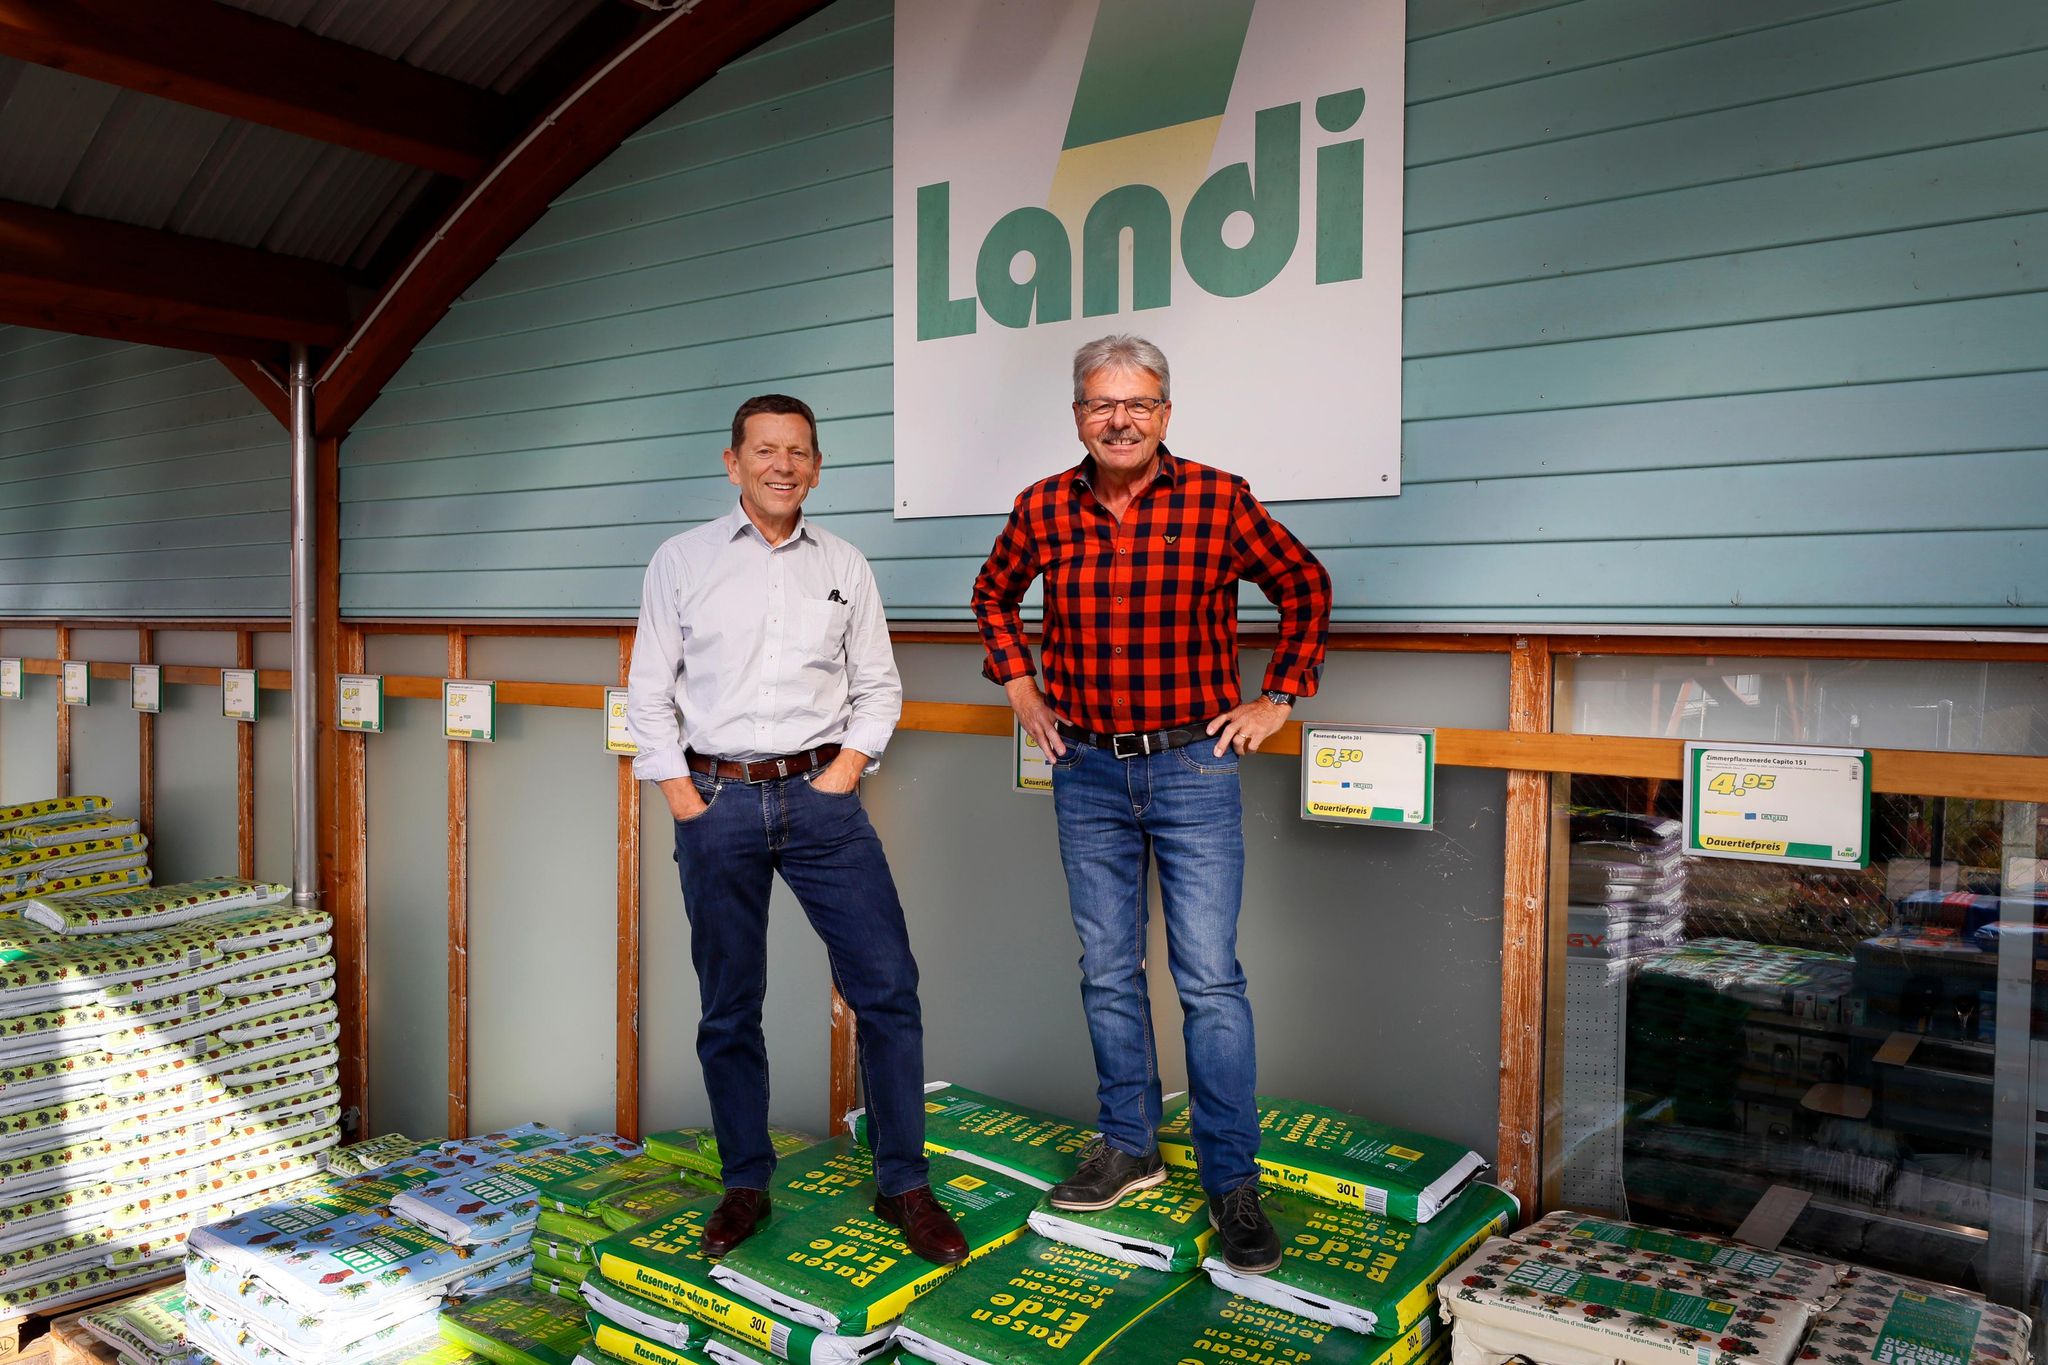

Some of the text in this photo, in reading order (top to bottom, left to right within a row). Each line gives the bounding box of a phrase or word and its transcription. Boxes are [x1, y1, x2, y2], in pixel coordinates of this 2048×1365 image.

[917, 88, 1365, 341] Landi
[1706, 754, 1772, 764] Zimmerpflanzenerde
[1773, 758, 1794, 766] Capito
[1313, 803, 1367, 815] Dauertiefpreis
[1706, 837, 1781, 852] Dauertiefpreis
[1837, 850, 1857, 858] Landi
[1282, 1169, 1308, 1184] Torf
[846, 1218, 904, 1236] gazon
[1119, 1200, 1192, 1224] Rase
[1313, 1211, 1411, 1240] de gazon
[629, 1209, 703, 1249] Rasen
[652, 1216, 705, 1254] Erd
[832, 1226, 912, 1255] terreau
[1305, 1220, 1405, 1252] terreau
[336, 1247, 381, 1272] ERDE
[809, 1239, 897, 1274] Erde
[1040, 1253, 1131, 1280] terriccio
[1049, 1246, 1108, 1264] tappeto
[1283, 1247, 1389, 1283] Rasen
[1295, 1234, 1398, 1269] Erde
[787, 1252, 876, 1288] Rasen
[1021, 1268, 1114, 1296] de gazon
[1508, 1261, 1550, 1285] ERDE
[636, 1269, 685, 1297] Rasenerde
[687, 1290, 709, 1308] ohne
[710, 1298, 731, 1316] Torf
[1008, 1278, 1104, 1309] terreau
[990, 1293, 1090, 1332] Erde
[1219, 1309, 1324, 1344] terriccio
[1227, 1301, 1297, 1322] tappeto
[1489, 1300, 1545, 1318] Zimmerpflanzenerde
[1549, 1314, 1570, 1325] Plantes
[1605, 1328, 1624, 1338] Piante
[1624, 1332, 1672, 1351] d'appartamento
[971, 1308, 1072, 1349] Rasen
[1204, 1328, 1311, 1362] de gazon
